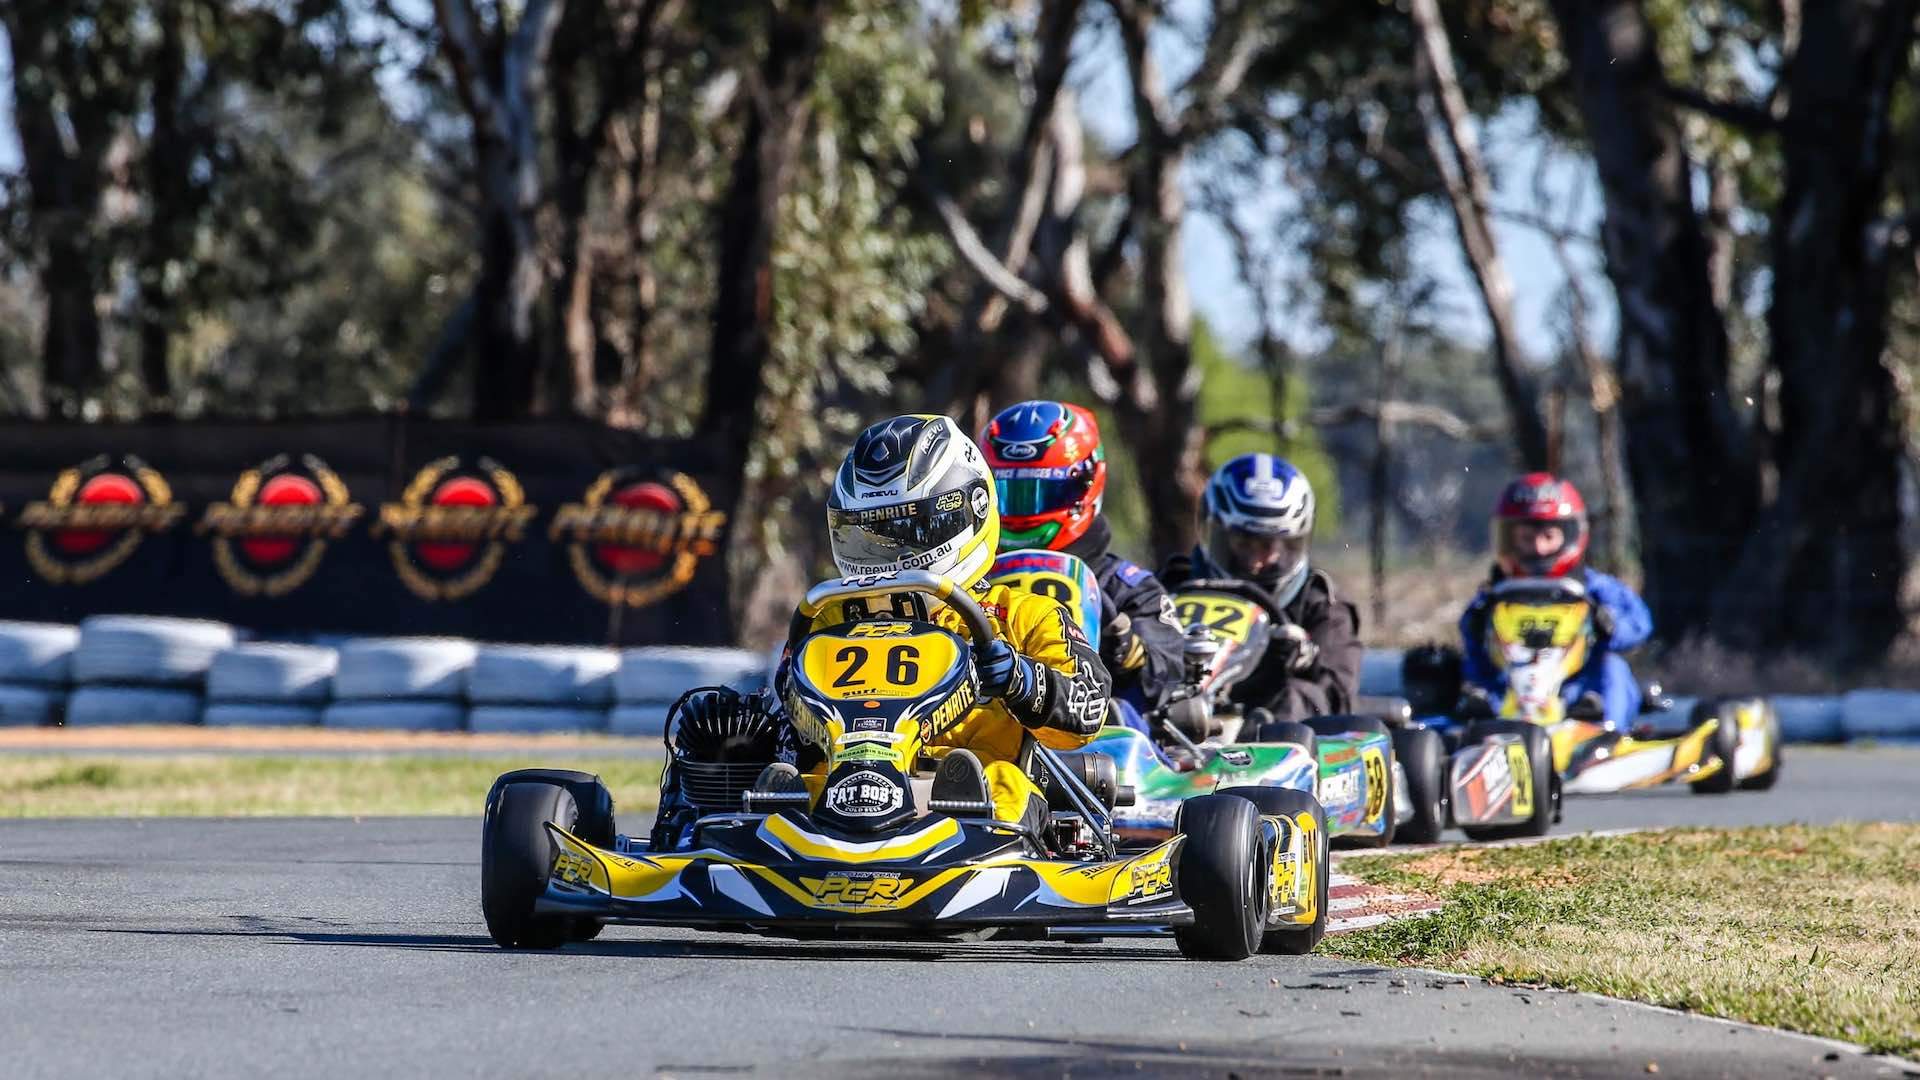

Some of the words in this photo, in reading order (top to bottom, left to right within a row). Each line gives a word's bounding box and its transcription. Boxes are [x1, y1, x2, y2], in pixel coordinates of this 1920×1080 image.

[860, 502, 918, 523] PENRITE
[838, 542, 953, 575] www.reevu.com.au
[932, 679, 975, 736] PENRITE
[826, 786, 858, 808] FAT
[860, 784, 904, 808] BOB'S
[815, 877, 901, 903] PCR
